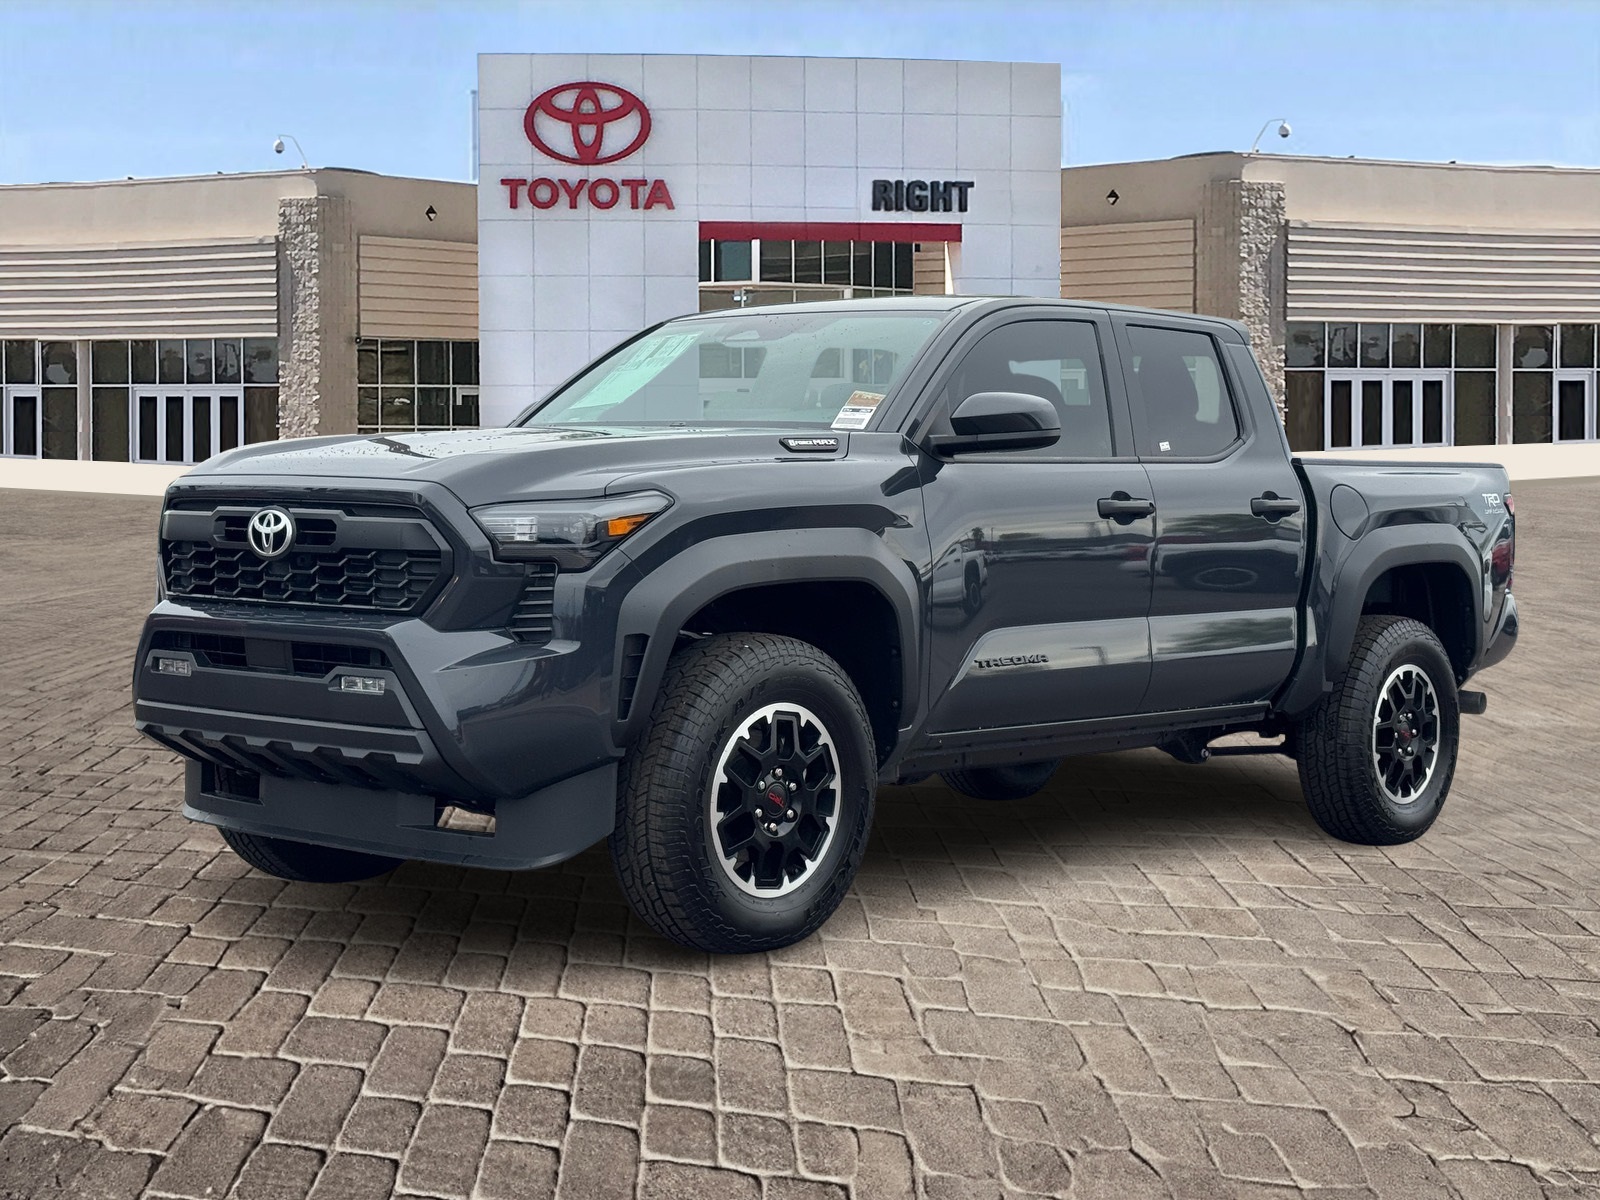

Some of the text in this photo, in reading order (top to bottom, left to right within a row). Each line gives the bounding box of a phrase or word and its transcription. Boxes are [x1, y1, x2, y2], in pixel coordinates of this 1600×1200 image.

[500, 178, 675, 209] TOYOTA
[872, 180, 974, 212] RIGHT
[1482, 493, 1500, 507] TRD
[974, 654, 1048, 668] TACOMA
